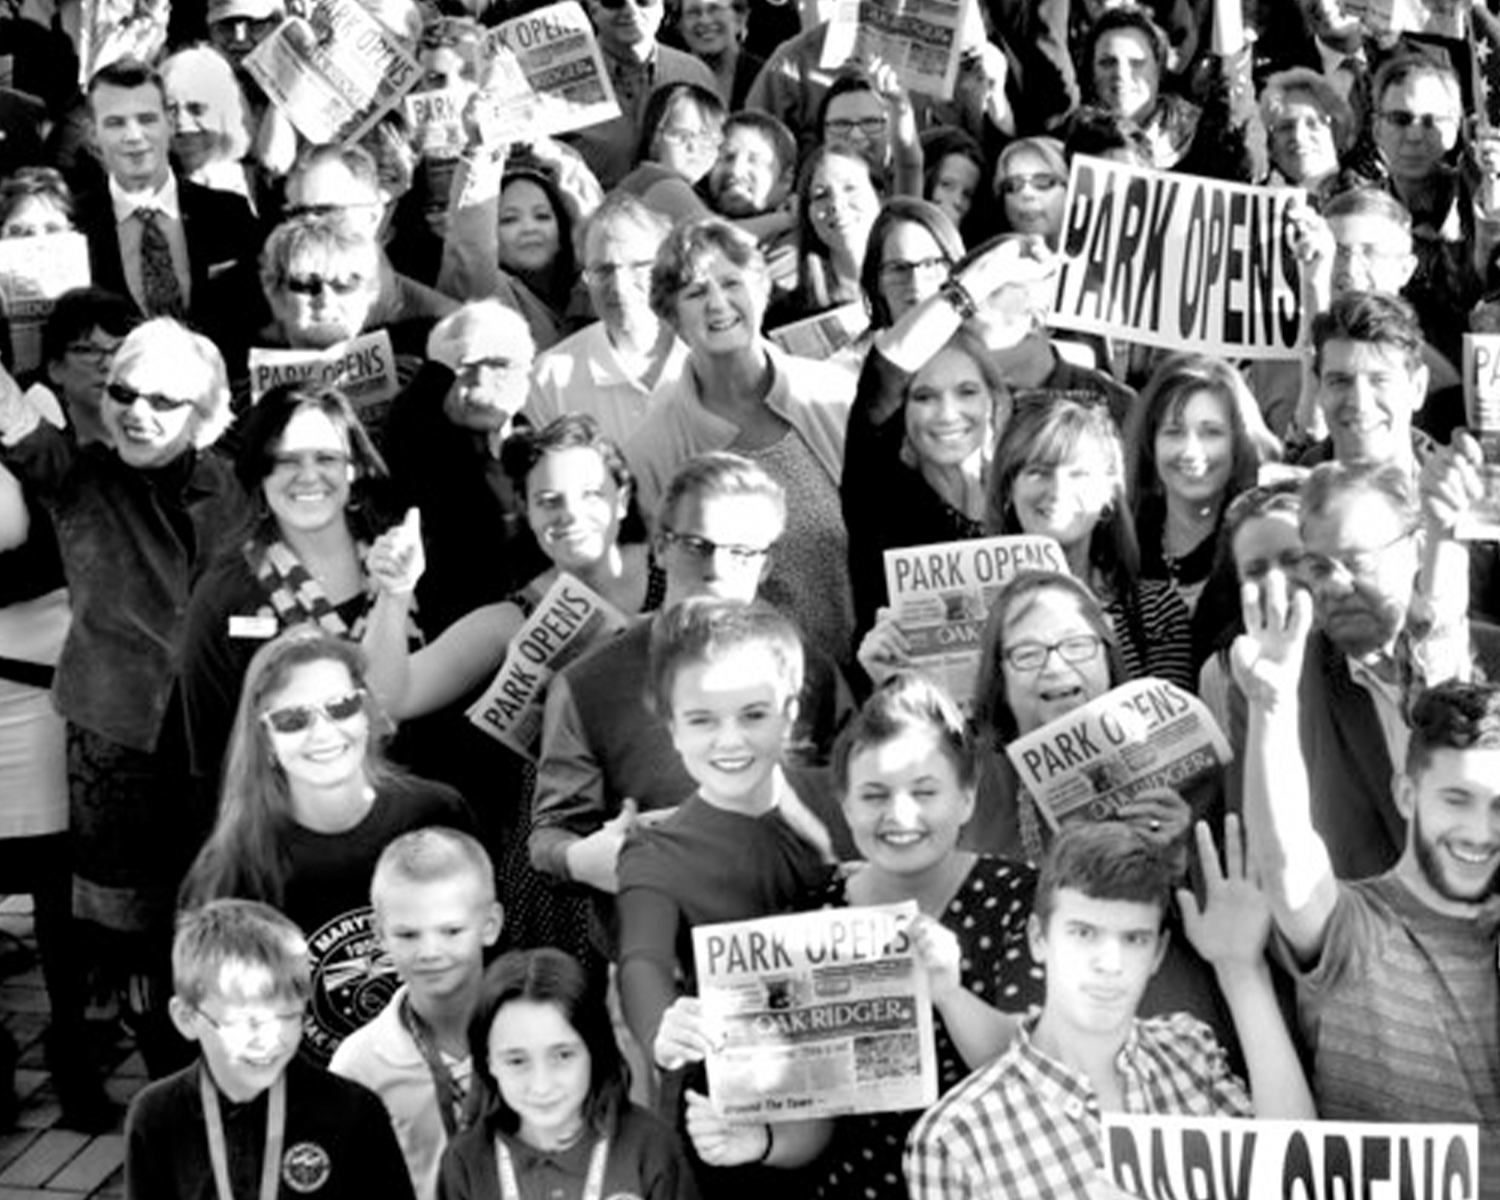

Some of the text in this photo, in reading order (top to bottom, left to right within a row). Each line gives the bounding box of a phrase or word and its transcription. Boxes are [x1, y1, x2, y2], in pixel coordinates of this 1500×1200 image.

[1054, 164, 1302, 348] PARK OPENS
[895, 543, 1060, 592] PARK OPENS
[482, 587, 593, 731] PARK OPENS
[1022, 684, 1190, 784] PARK OENS
[707, 931, 793, 976] PARK
[811, 999, 903, 1030] RIDGER
